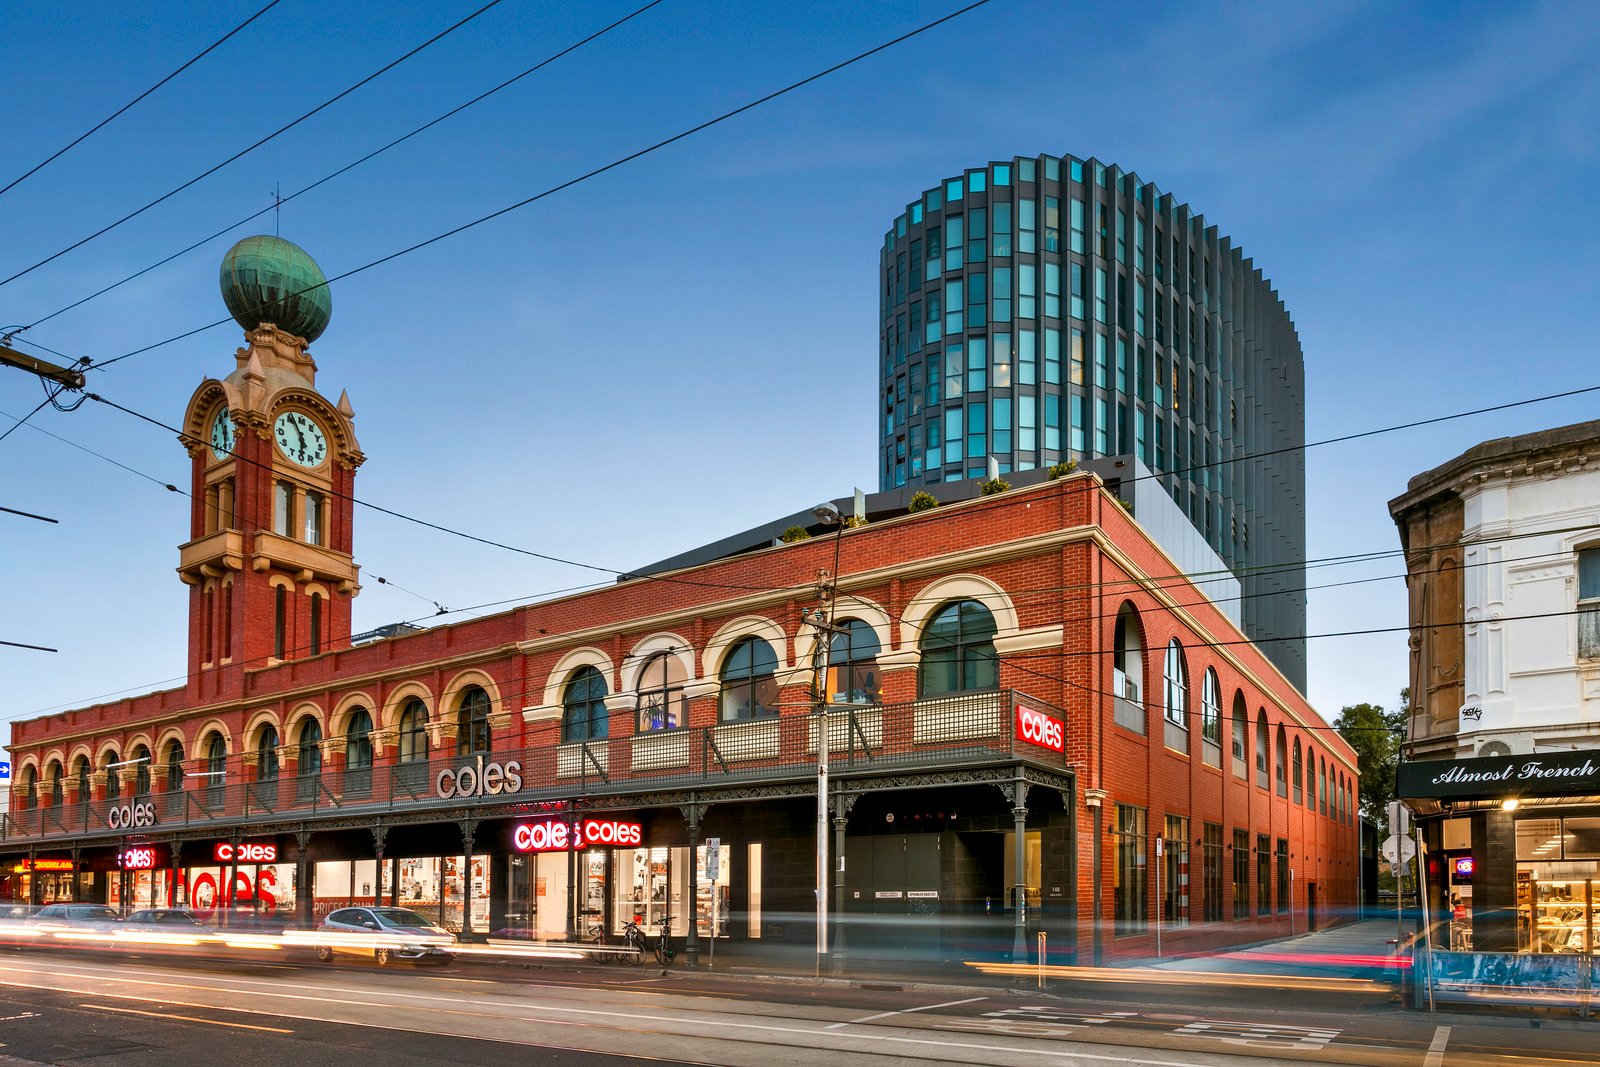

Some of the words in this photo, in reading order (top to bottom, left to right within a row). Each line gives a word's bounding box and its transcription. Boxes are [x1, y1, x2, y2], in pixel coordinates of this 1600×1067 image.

[1021, 711, 1062, 749] coles
[436, 755, 522, 799] coles
[1432, 764, 1515, 785] Almost
[1518, 759, 1600, 780] French
[109, 797, 156, 830] coles
[585, 821, 640, 844] coles
[217, 844, 276, 861] coles
